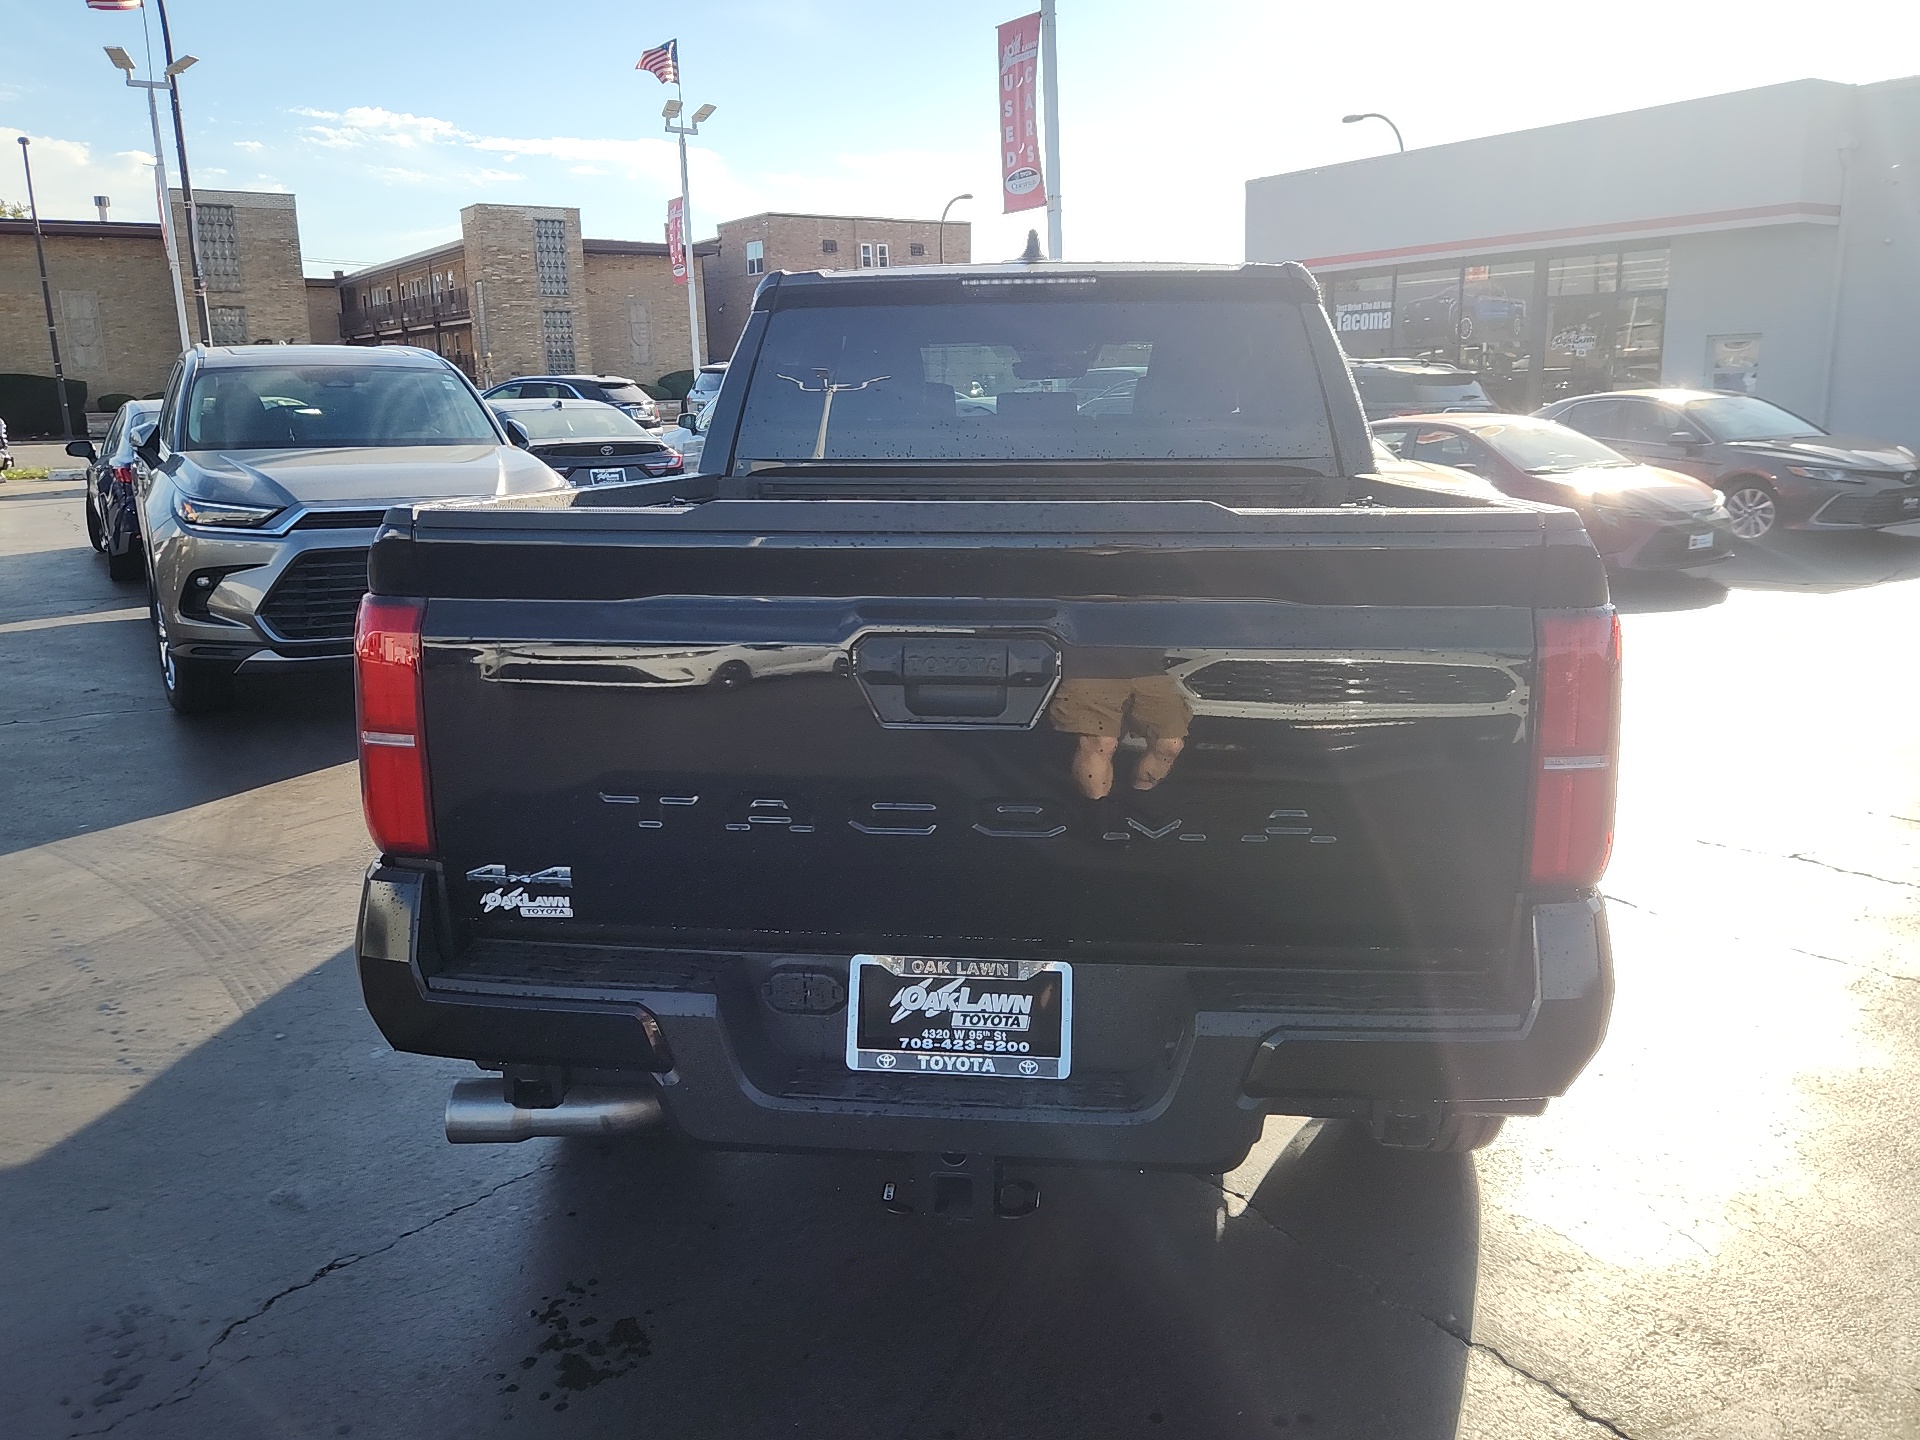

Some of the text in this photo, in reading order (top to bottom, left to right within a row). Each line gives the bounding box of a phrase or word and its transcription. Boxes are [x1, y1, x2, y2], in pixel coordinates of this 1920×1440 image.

[1003, 73, 1017, 168] USED
[1024, 65, 1035, 163] CARS
[1335, 311, 1391, 332] Tacoma
[908, 655, 1001, 673] TOYOTA
[598, 791, 1338, 843] TACOMA
[911, 960, 1009, 977] OAK LAWN
[960, 1013, 1021, 1028] TOYOTA
[921, 1028, 1007, 1041] 4320 W 95th St
[899, 1037, 1030, 1053] 708-423-5200
[917, 1055, 996, 1073] TOYOTA
